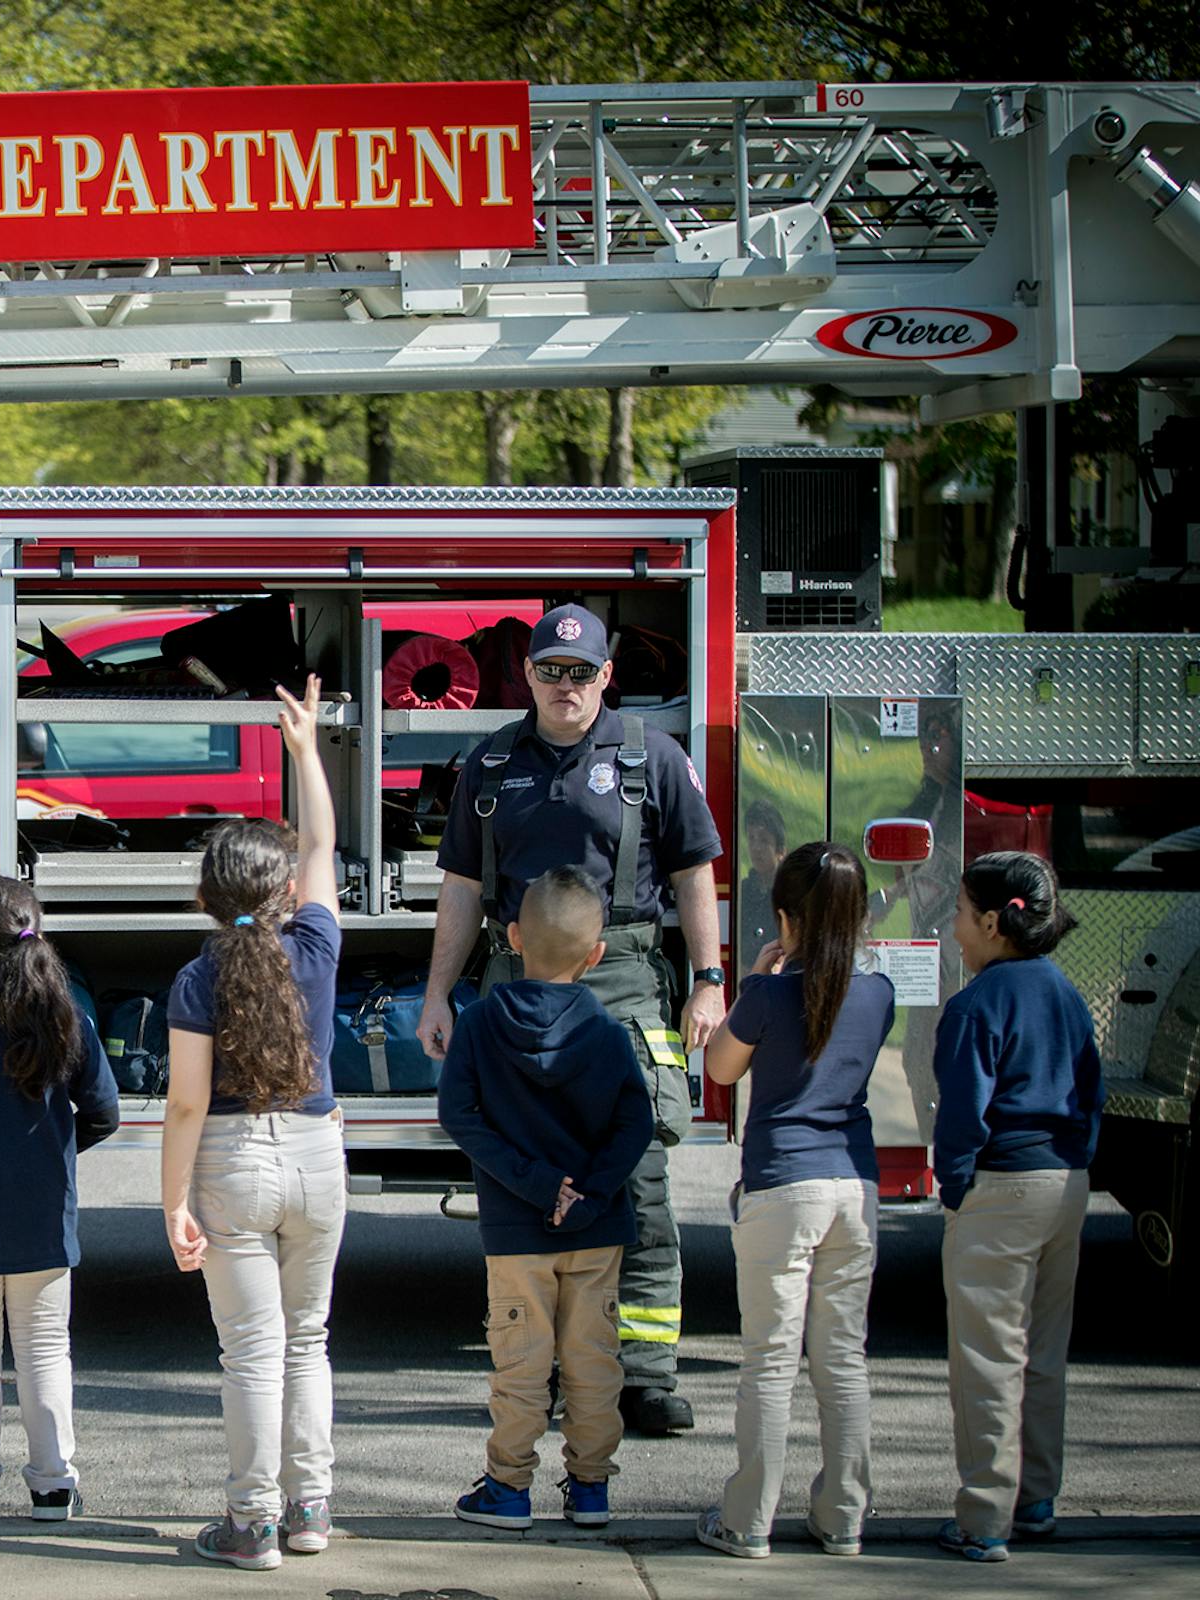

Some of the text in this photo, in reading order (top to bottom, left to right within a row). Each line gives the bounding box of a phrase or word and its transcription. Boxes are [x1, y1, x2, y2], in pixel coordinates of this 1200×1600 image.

[836, 89, 864, 107] 60
[862, 315, 971, 350] Pierce
[800, 579, 852, 590] Harrison
